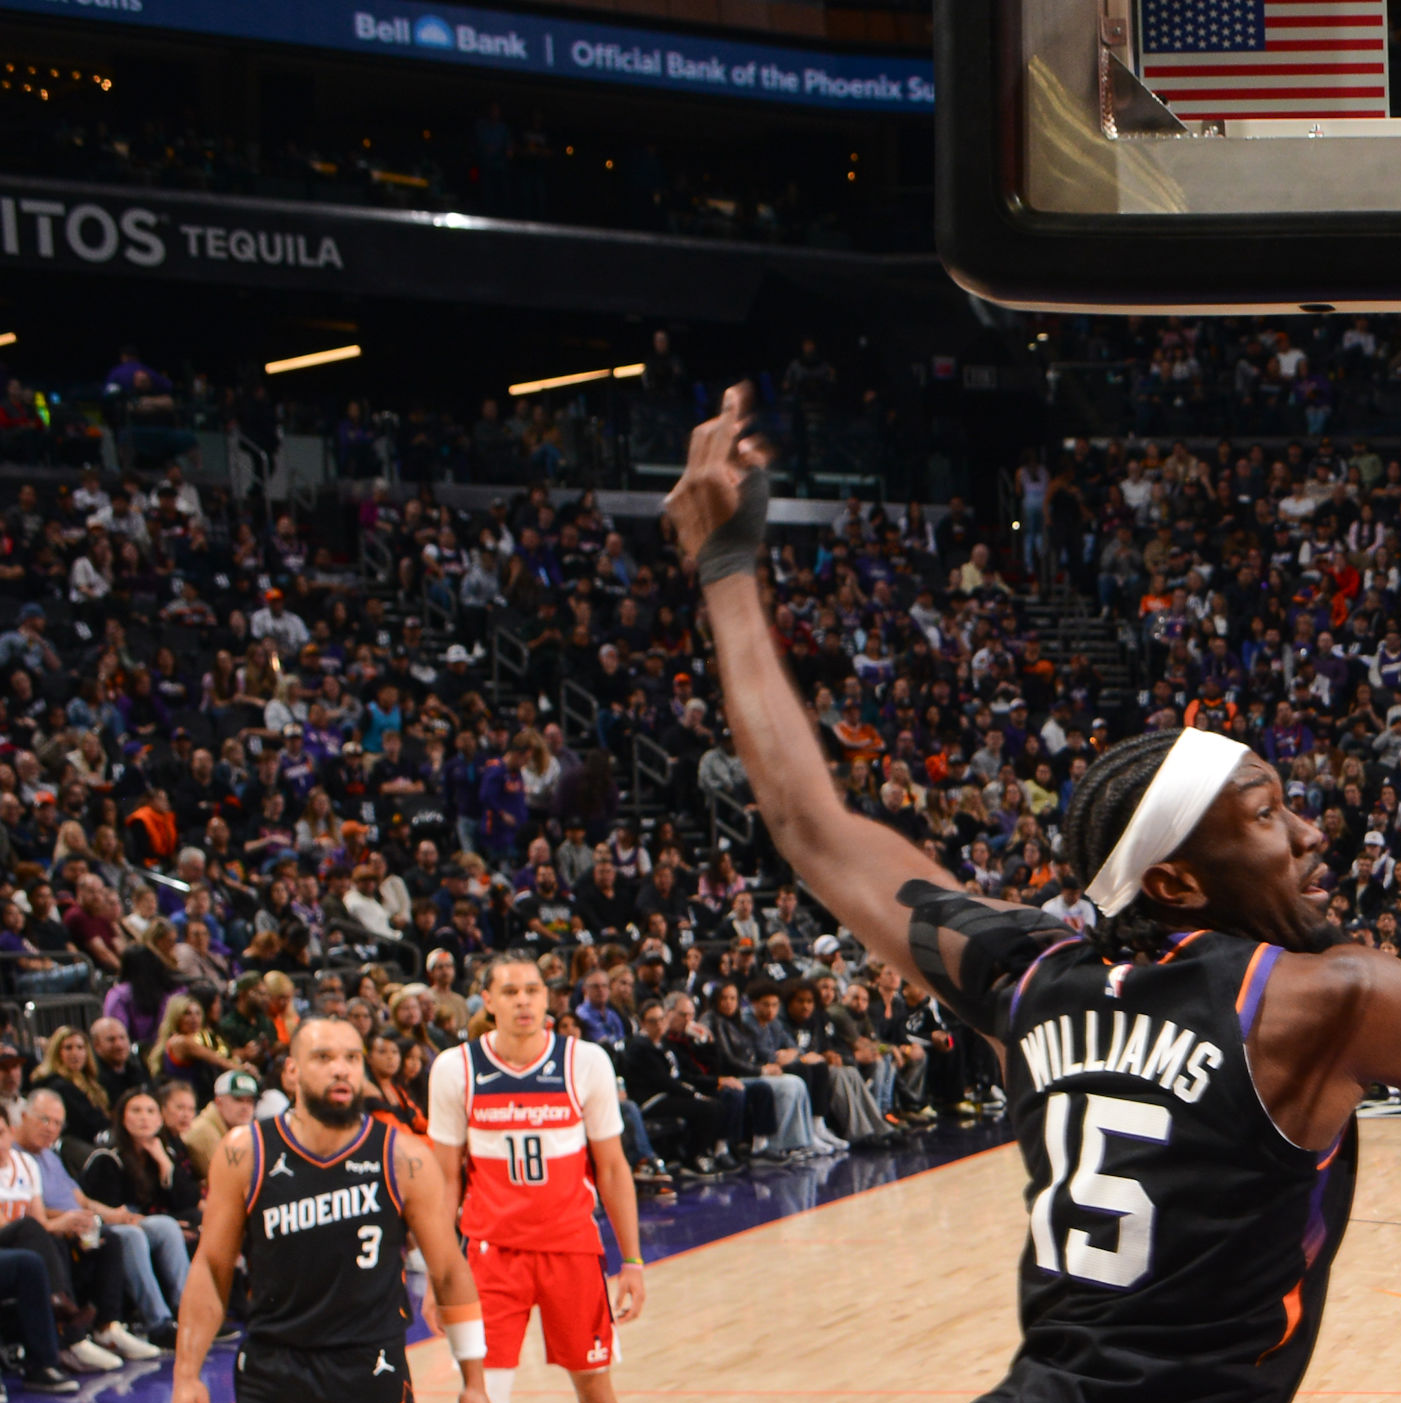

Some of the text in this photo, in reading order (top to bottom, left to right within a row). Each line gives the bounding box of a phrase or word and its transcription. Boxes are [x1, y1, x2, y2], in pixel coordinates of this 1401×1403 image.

[355, 12, 934, 102] Bell Bank Official Bank of the Phoenix Su
[180, 225, 344, 270] TEQUILA
[1020, 1010, 1224, 1104] WILLIAMS
[473, 1101, 571, 1126] washington
[345, 1160, 381, 1175] PayPal
[504, 1133, 549, 1186] 18
[263, 1181, 382, 1240] PHOENIX
[1031, 1092, 1173, 1292] 15
[356, 1225, 383, 1269] 3
